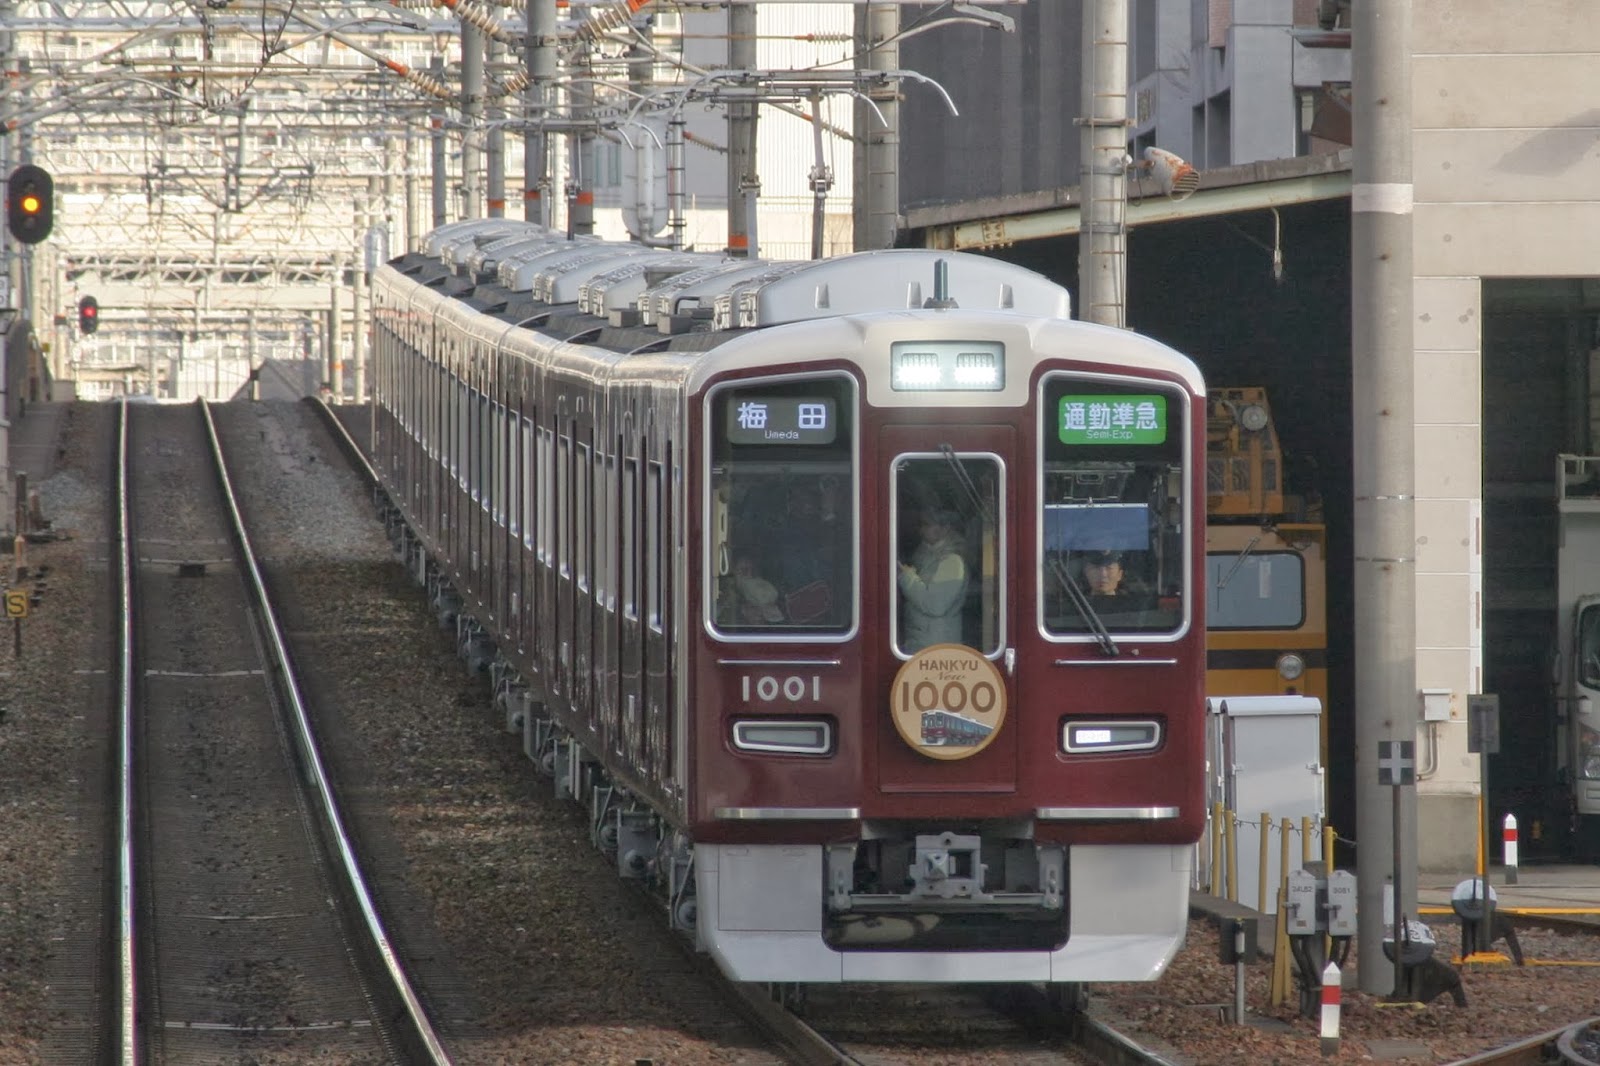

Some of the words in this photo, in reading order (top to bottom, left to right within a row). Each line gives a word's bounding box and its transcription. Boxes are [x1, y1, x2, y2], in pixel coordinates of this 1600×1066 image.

[1064, 402, 1158, 430] 通勤準急
[764, 430, 799, 439] Umeda
[8, 594, 24, 615] S
[919, 659, 979, 671] HANKYU
[742, 675, 820, 702] 1001
[902, 681, 996, 713] 1000
